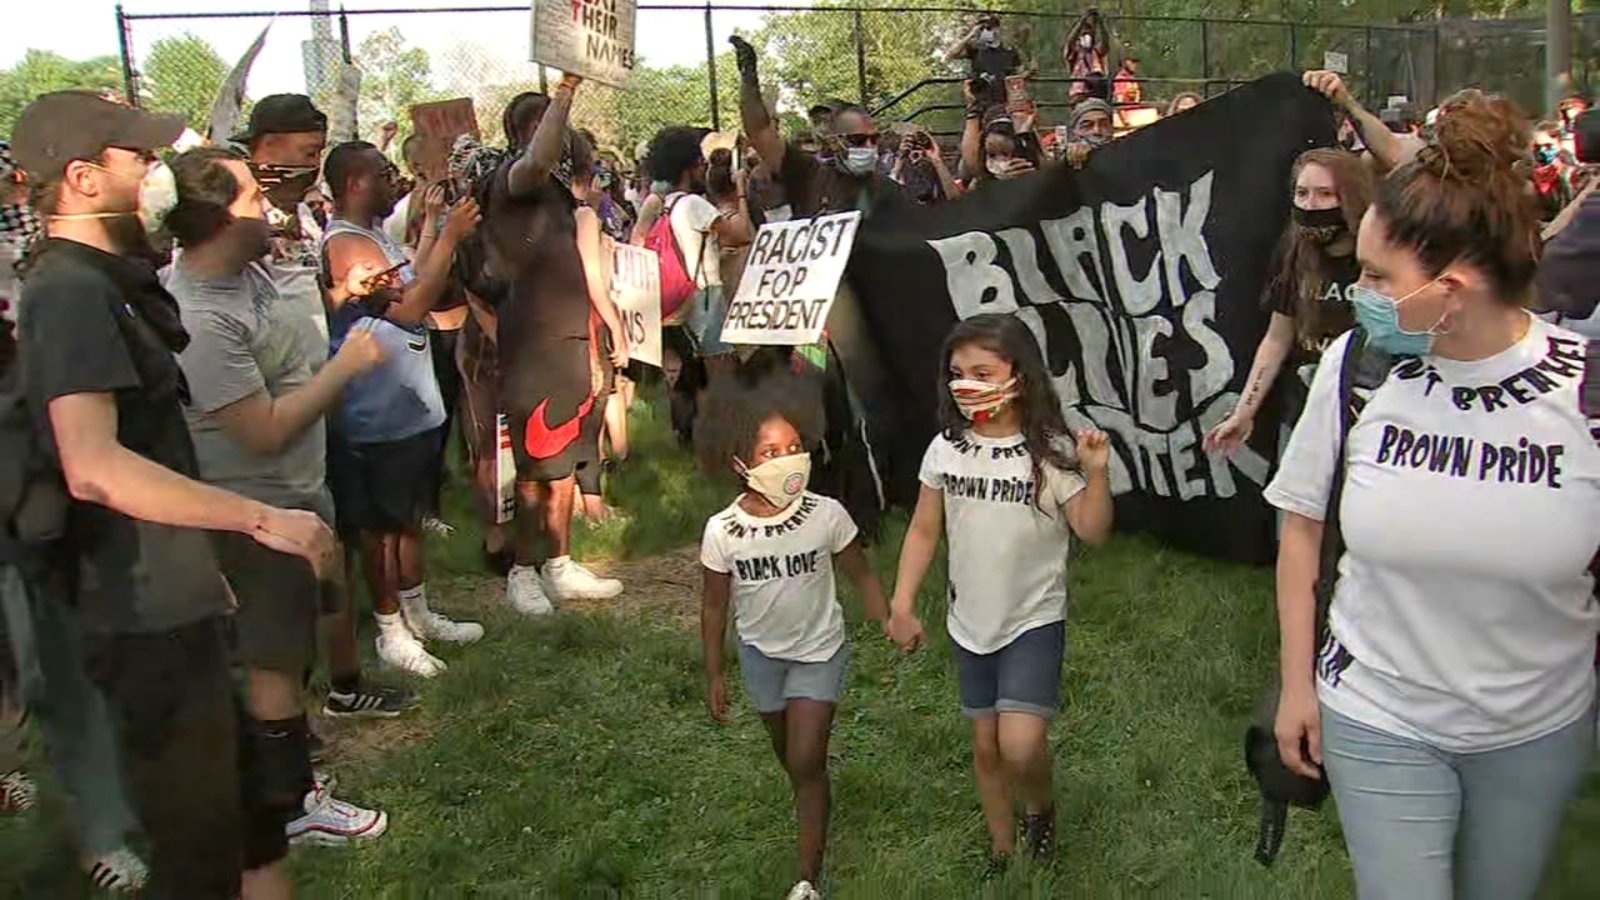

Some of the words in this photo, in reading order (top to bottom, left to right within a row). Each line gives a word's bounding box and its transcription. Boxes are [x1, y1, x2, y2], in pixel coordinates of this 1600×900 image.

[571, 0, 617, 40] THEIR
[750, 218, 854, 266] RACIST
[926, 169, 1222, 321] BLACK
[725, 299, 828, 331] PRESIDENT
[1015, 290, 1235, 433] LIVES
[1376, 424, 1473, 477] BROWN
[735, 555, 782, 581] BLACK
[785, 550, 818, 578] LOVE
